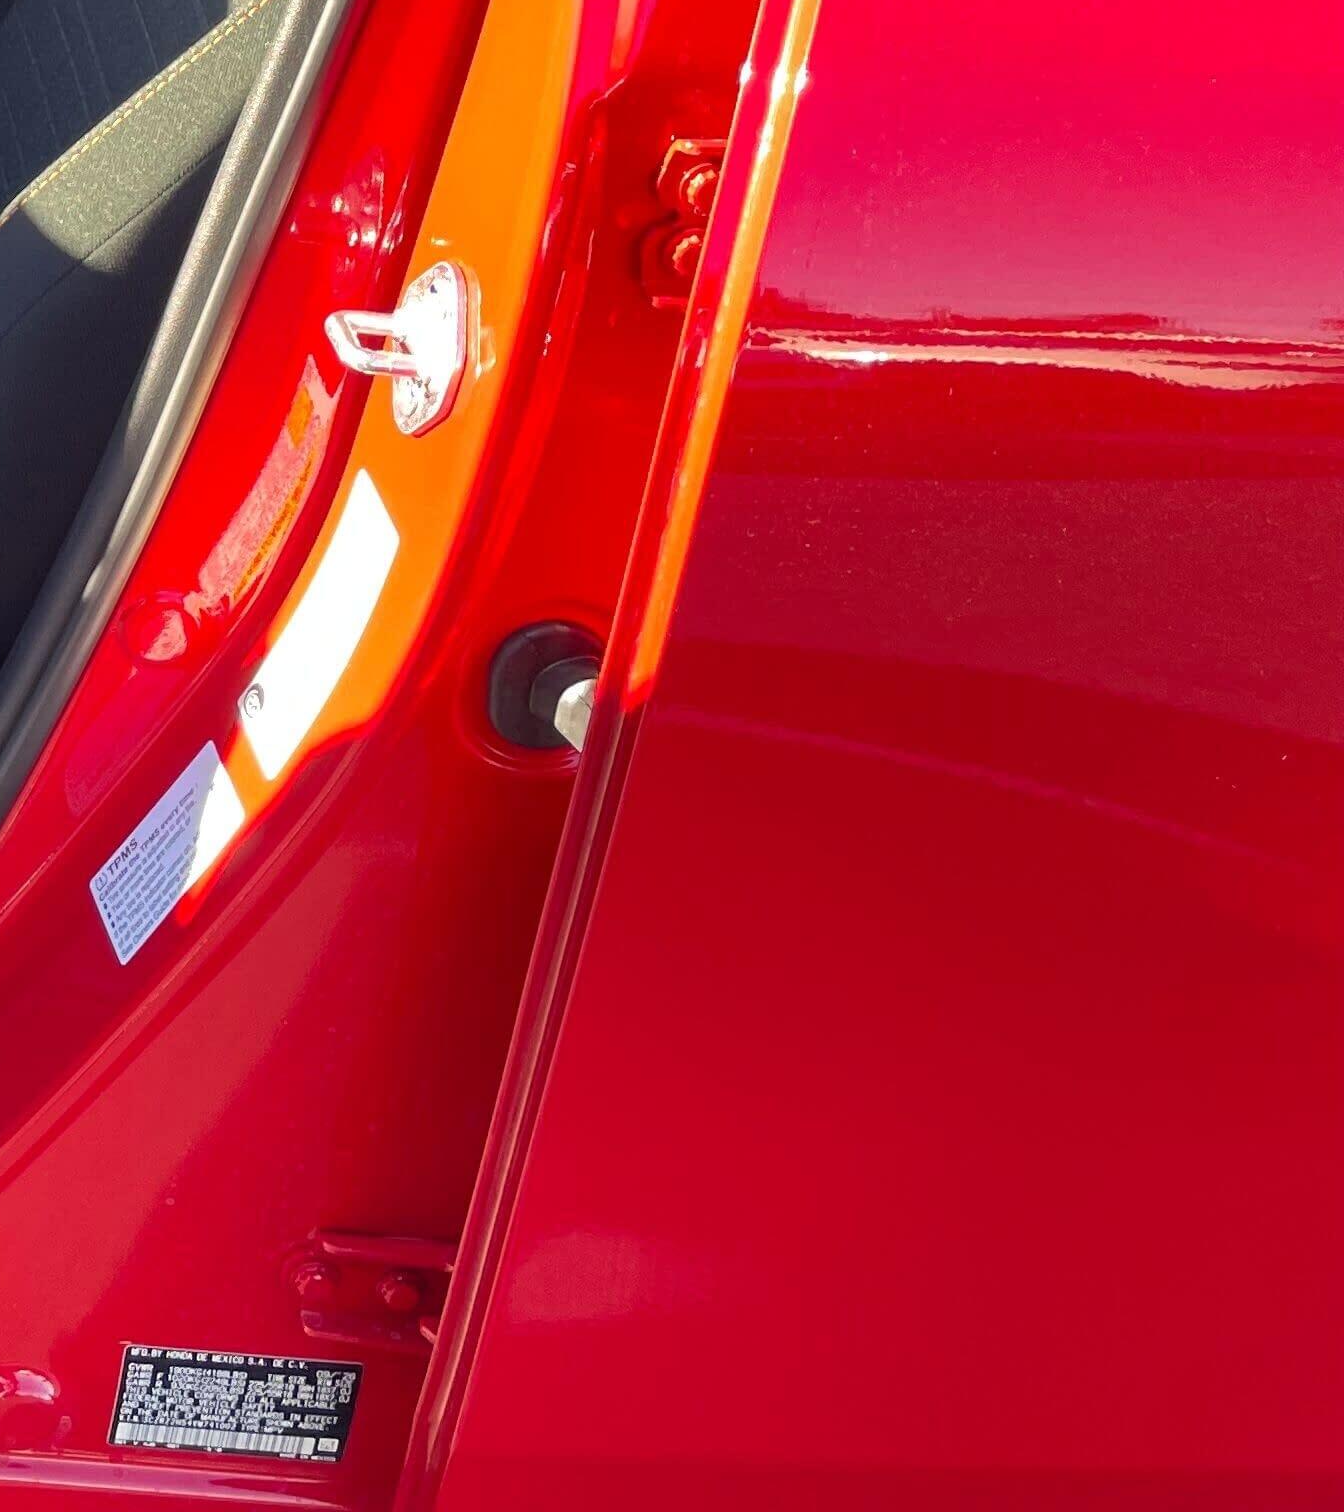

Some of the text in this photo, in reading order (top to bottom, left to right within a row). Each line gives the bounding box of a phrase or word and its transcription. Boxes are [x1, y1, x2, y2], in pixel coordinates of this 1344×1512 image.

[108, 839, 137, 874] TPMS
[165, 1351, 193, 1360] HONDA
[196, 1353, 208, 1361] DE
[211, 1354, 244, 1364] MEXICO
[272, 1359, 284, 1367] DE
